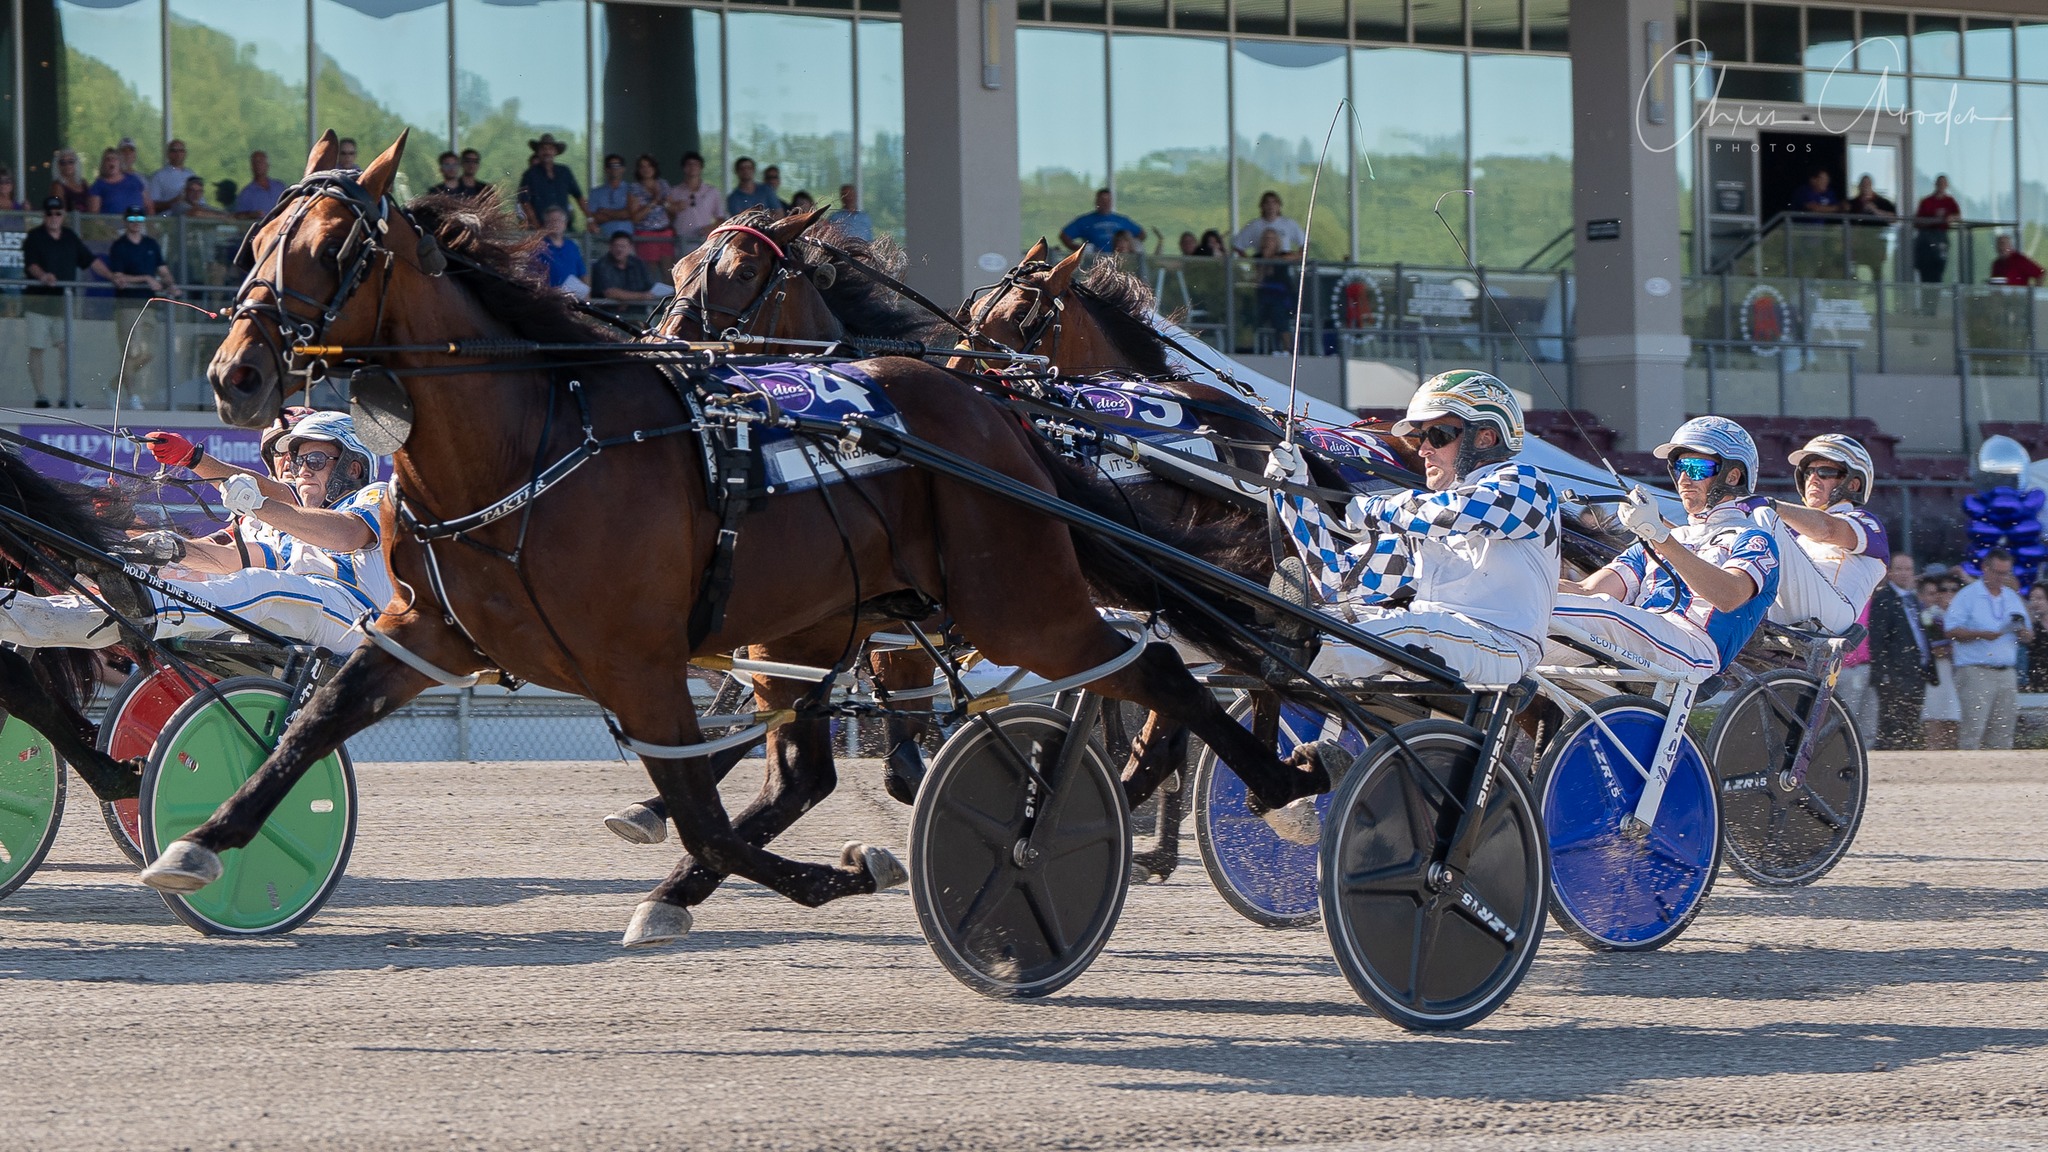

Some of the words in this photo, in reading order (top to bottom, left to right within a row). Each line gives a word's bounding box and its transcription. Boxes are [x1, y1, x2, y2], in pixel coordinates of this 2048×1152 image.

[804, 367, 875, 412] 4
[208, 434, 260, 464] Home
[122, 562, 147, 580] HOLD
[148, 573, 164, 590] THE
[165, 583, 185, 598] LINE
[186, 593, 217, 613] STABLE
[1589, 633, 1619, 652] SCOTT
[1621, 649, 1652, 669] ZERON
[1476, 707, 1514, 809] TAKTER
